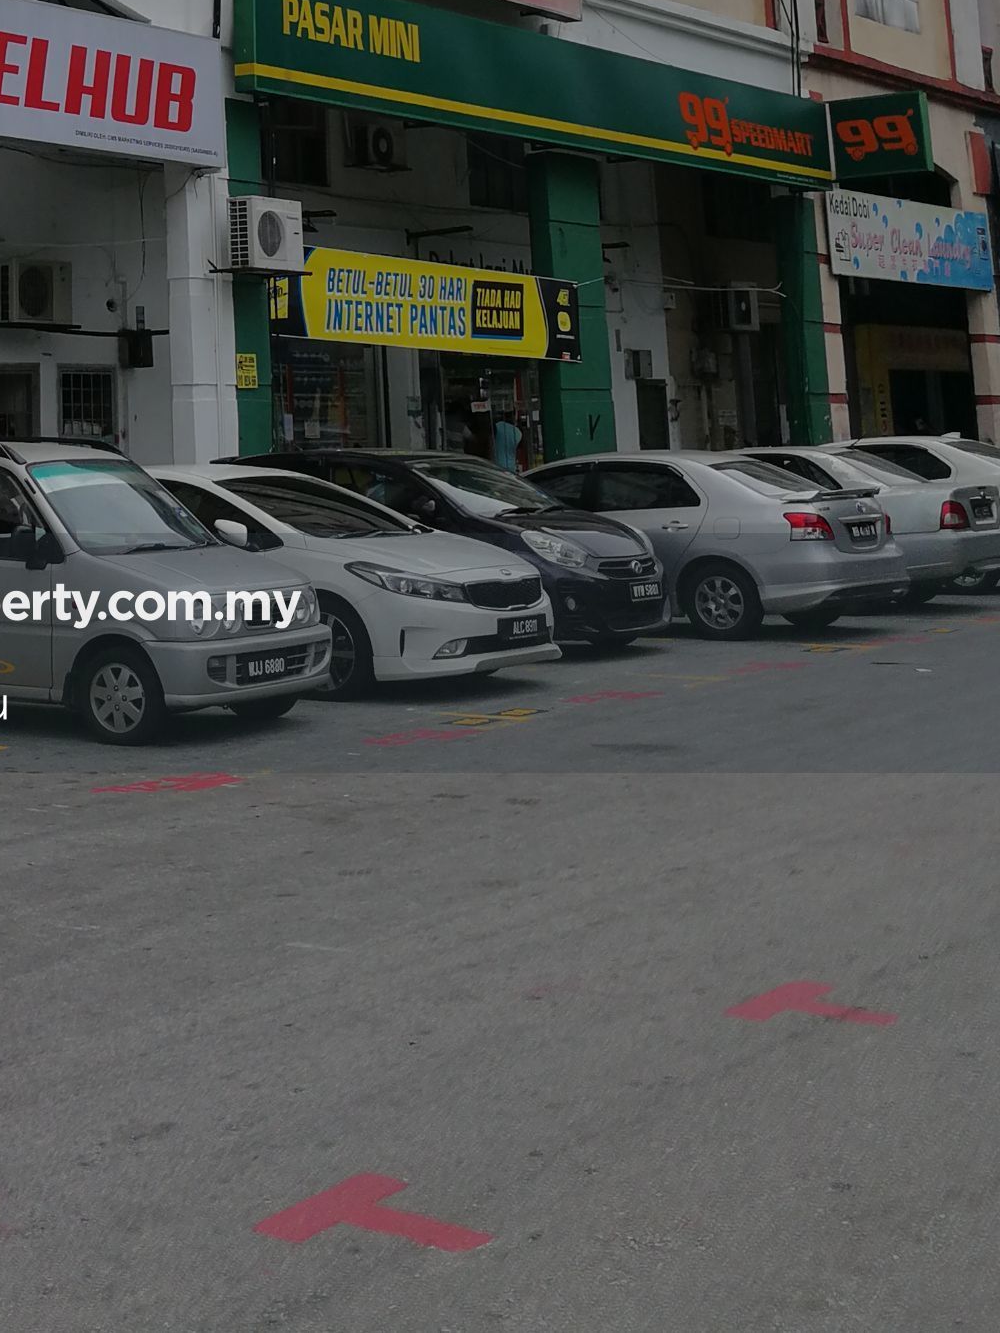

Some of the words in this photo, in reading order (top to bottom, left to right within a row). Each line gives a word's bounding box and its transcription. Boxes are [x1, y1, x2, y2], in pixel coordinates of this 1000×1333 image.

[369, 14, 421, 63] MINI
[677, 91, 732, 157] 99
[730, 118, 814, 157] SPEEDMART
[835, 108, 919, 162] 99
[829, 192, 851, 216] Kedai
[852, 197, 871, 219] Dobi
[851, 221, 884, 258] Super
[890, 228, 923, 258] Clean
[326, 267, 413, 299] BETUL-BETUL
[419, 274, 435, 300] 30
[439, 276, 467, 302] HARI
[476, 288, 501, 308] TIADA
[503, 290, 522, 309] HAD
[325, 298, 404, 334] INTERNET
[409, 304, 467, 339] PANTAS
[475, 309, 522, 330] KELAJUAN
[512, 620, 524, 635] ALC
